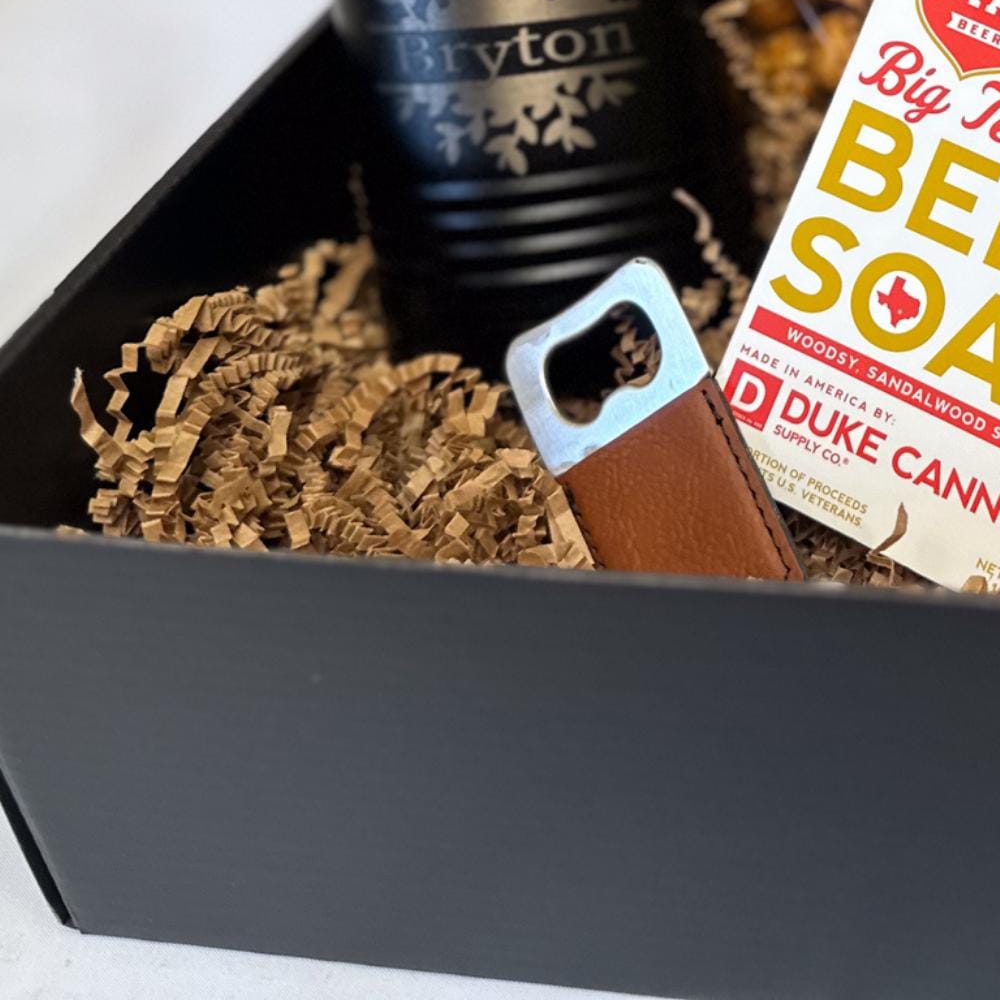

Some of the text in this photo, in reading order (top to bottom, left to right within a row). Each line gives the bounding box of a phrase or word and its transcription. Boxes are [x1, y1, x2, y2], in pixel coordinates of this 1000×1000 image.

[397, 21, 636, 80] Bryton
[858, 40, 952, 124] Big
[730, 370, 767, 413] D
[740, 344, 897, 426] MADE IN AMERICA BY:
[786, 325, 862, 375] WOODSY,
[867, 366, 987, 433] SANDALWOOD
[773, 424, 821, 454] SUPPLY
[780, 388, 888, 464] DUKE
[776, 476, 798, 495] U.S.
[789, 468, 807, 483] OF
[807, 477, 869, 514] PROCEEDS
